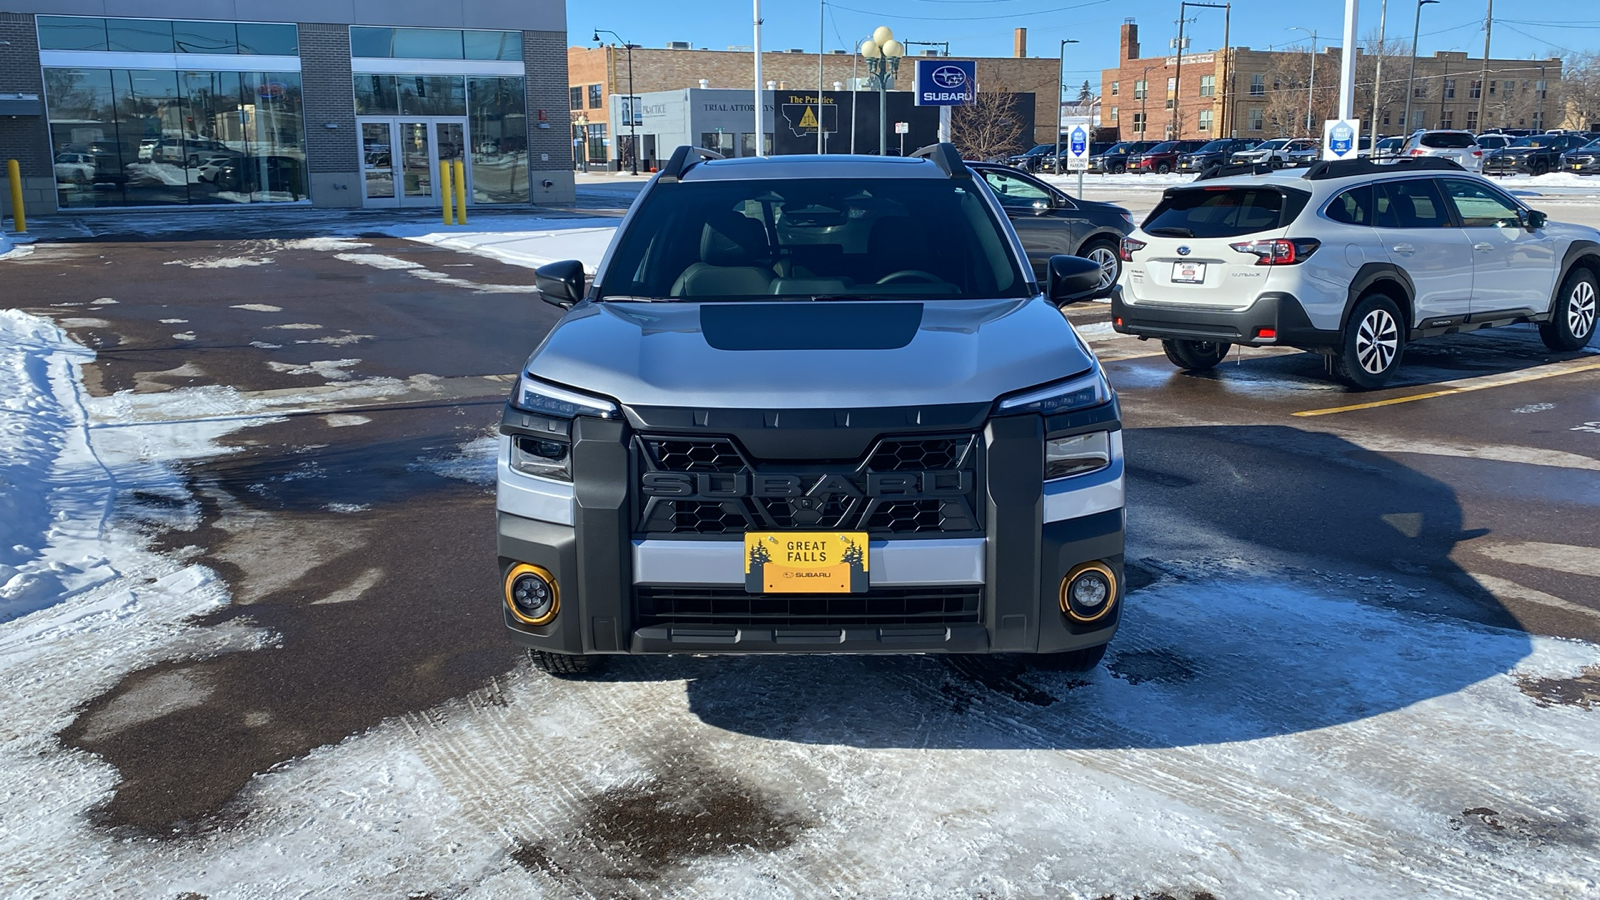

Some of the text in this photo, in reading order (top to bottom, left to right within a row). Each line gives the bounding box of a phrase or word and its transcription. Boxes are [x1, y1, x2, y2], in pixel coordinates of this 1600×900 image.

[789, 95, 804, 104] The
[923, 92, 972, 101] SUBARU
[643, 104, 666, 115] PRACTICE
[703, 104, 728, 112] TRIAL
[642, 470, 976, 497] SUBARU
[786, 541, 827, 551] GREAT
[786, 551, 827, 562] FALLS
